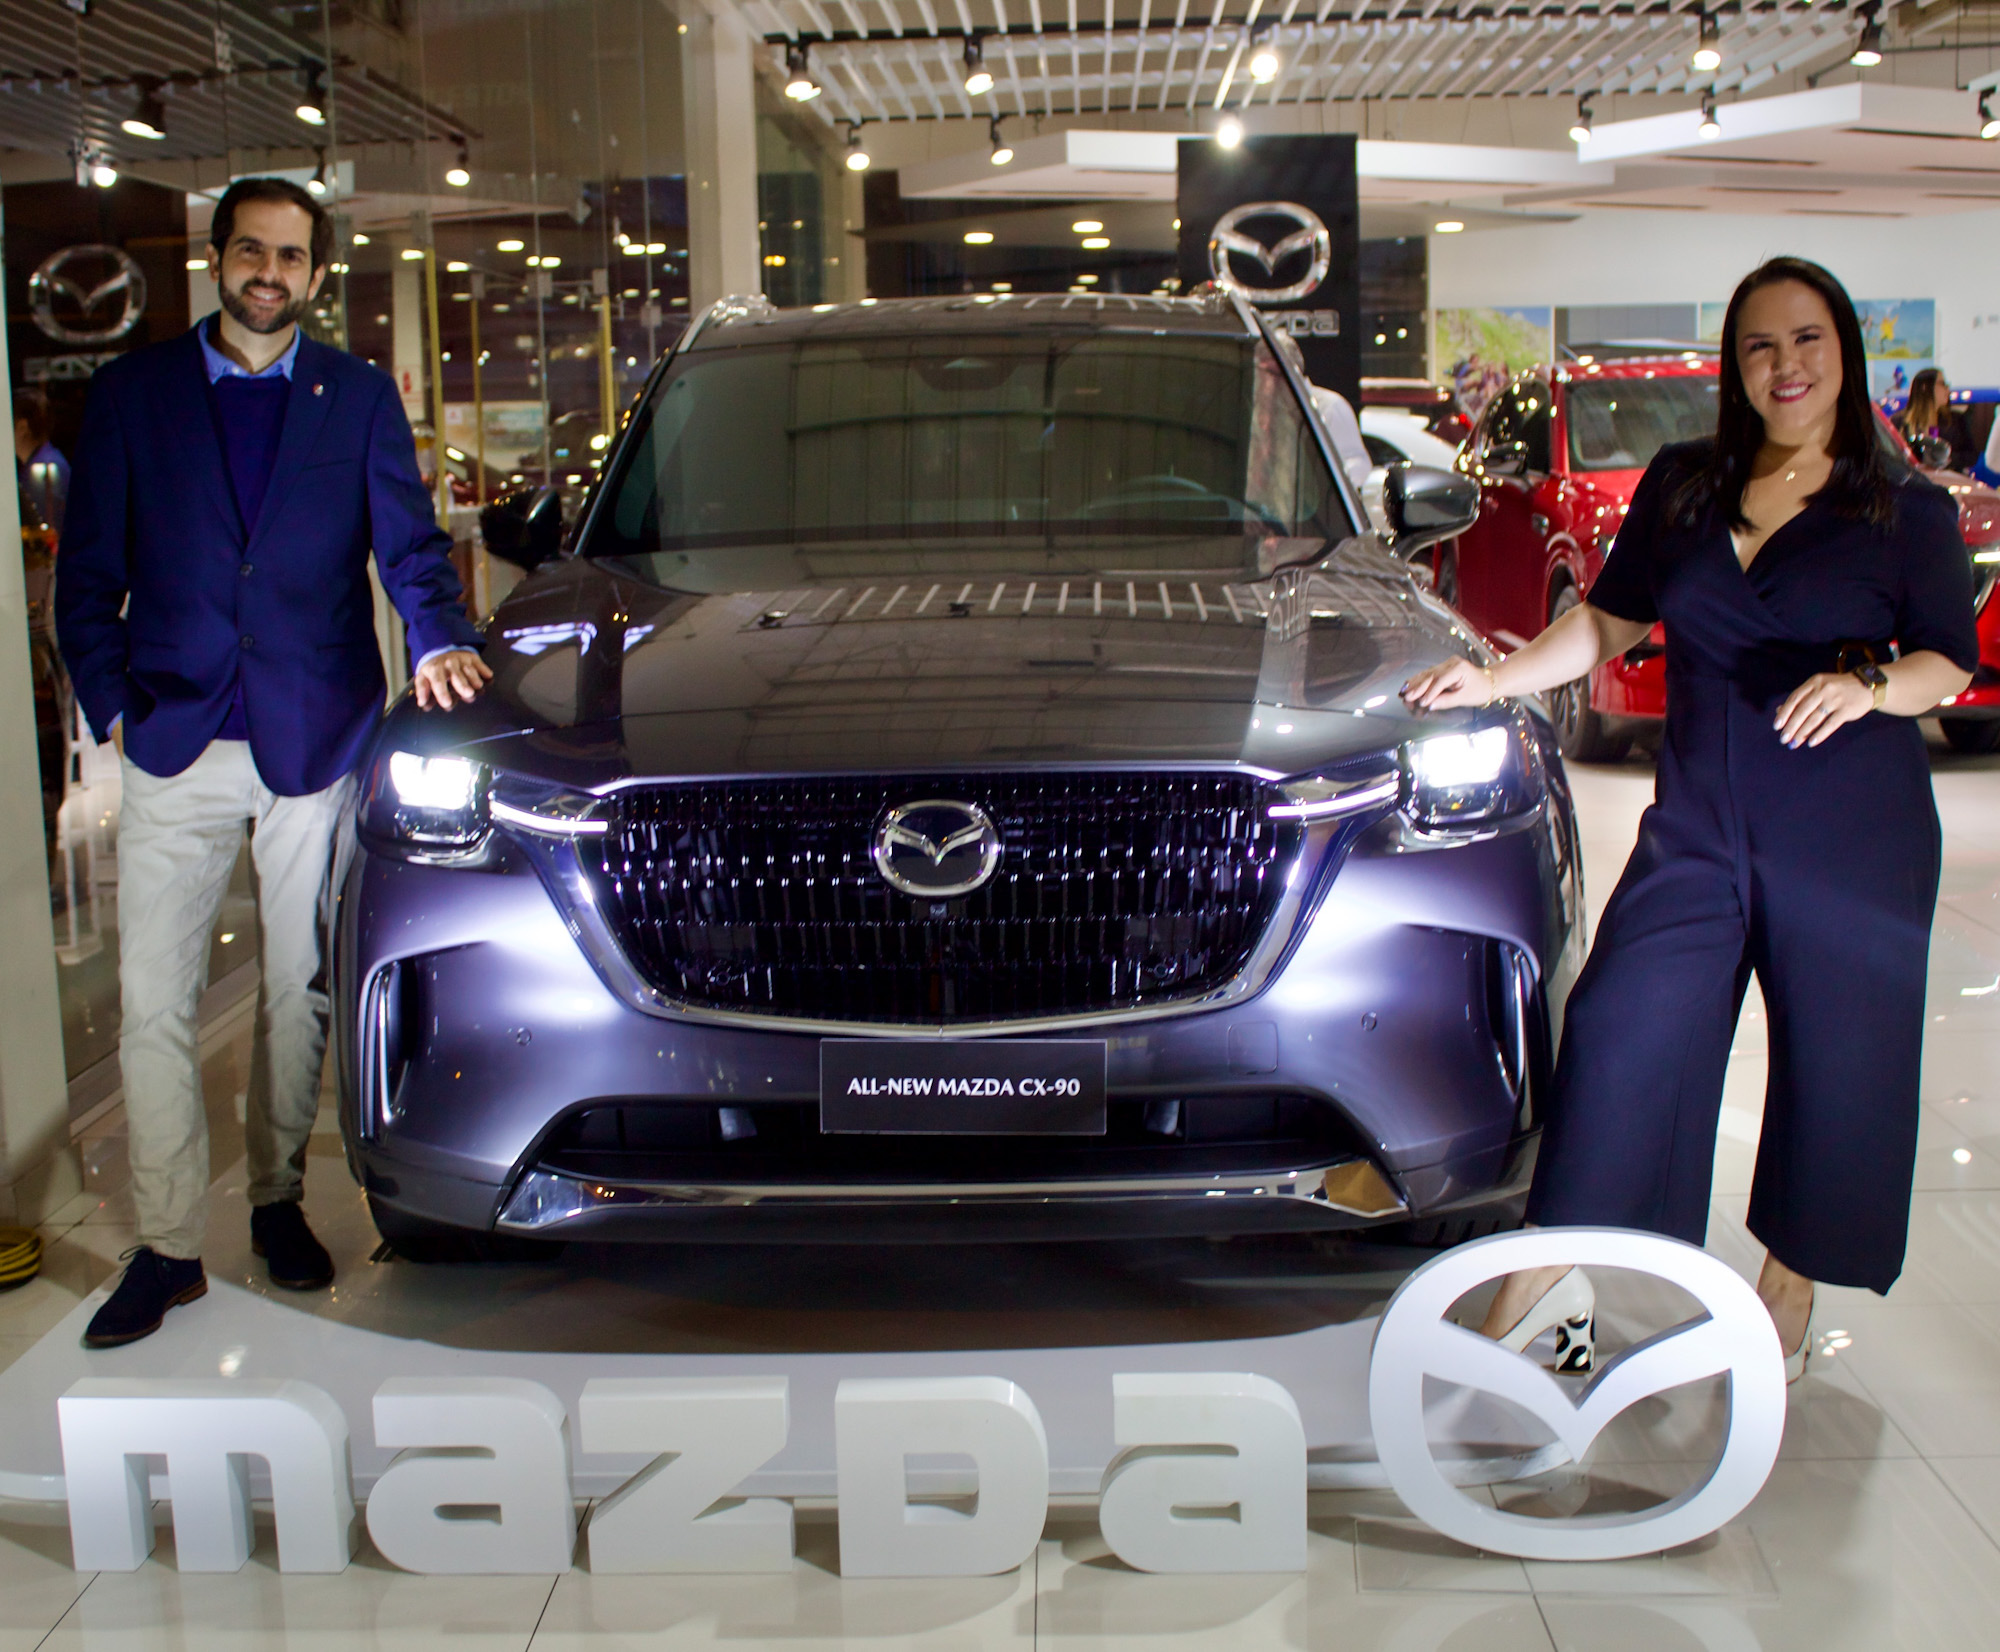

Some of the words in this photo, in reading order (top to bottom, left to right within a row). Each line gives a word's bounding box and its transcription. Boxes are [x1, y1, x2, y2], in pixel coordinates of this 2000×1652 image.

[847, 1077, 934, 1096] ALL-NEW
[937, 1077, 1015, 1096] MAZDA
[1018, 1077, 1081, 1096] CX-90
